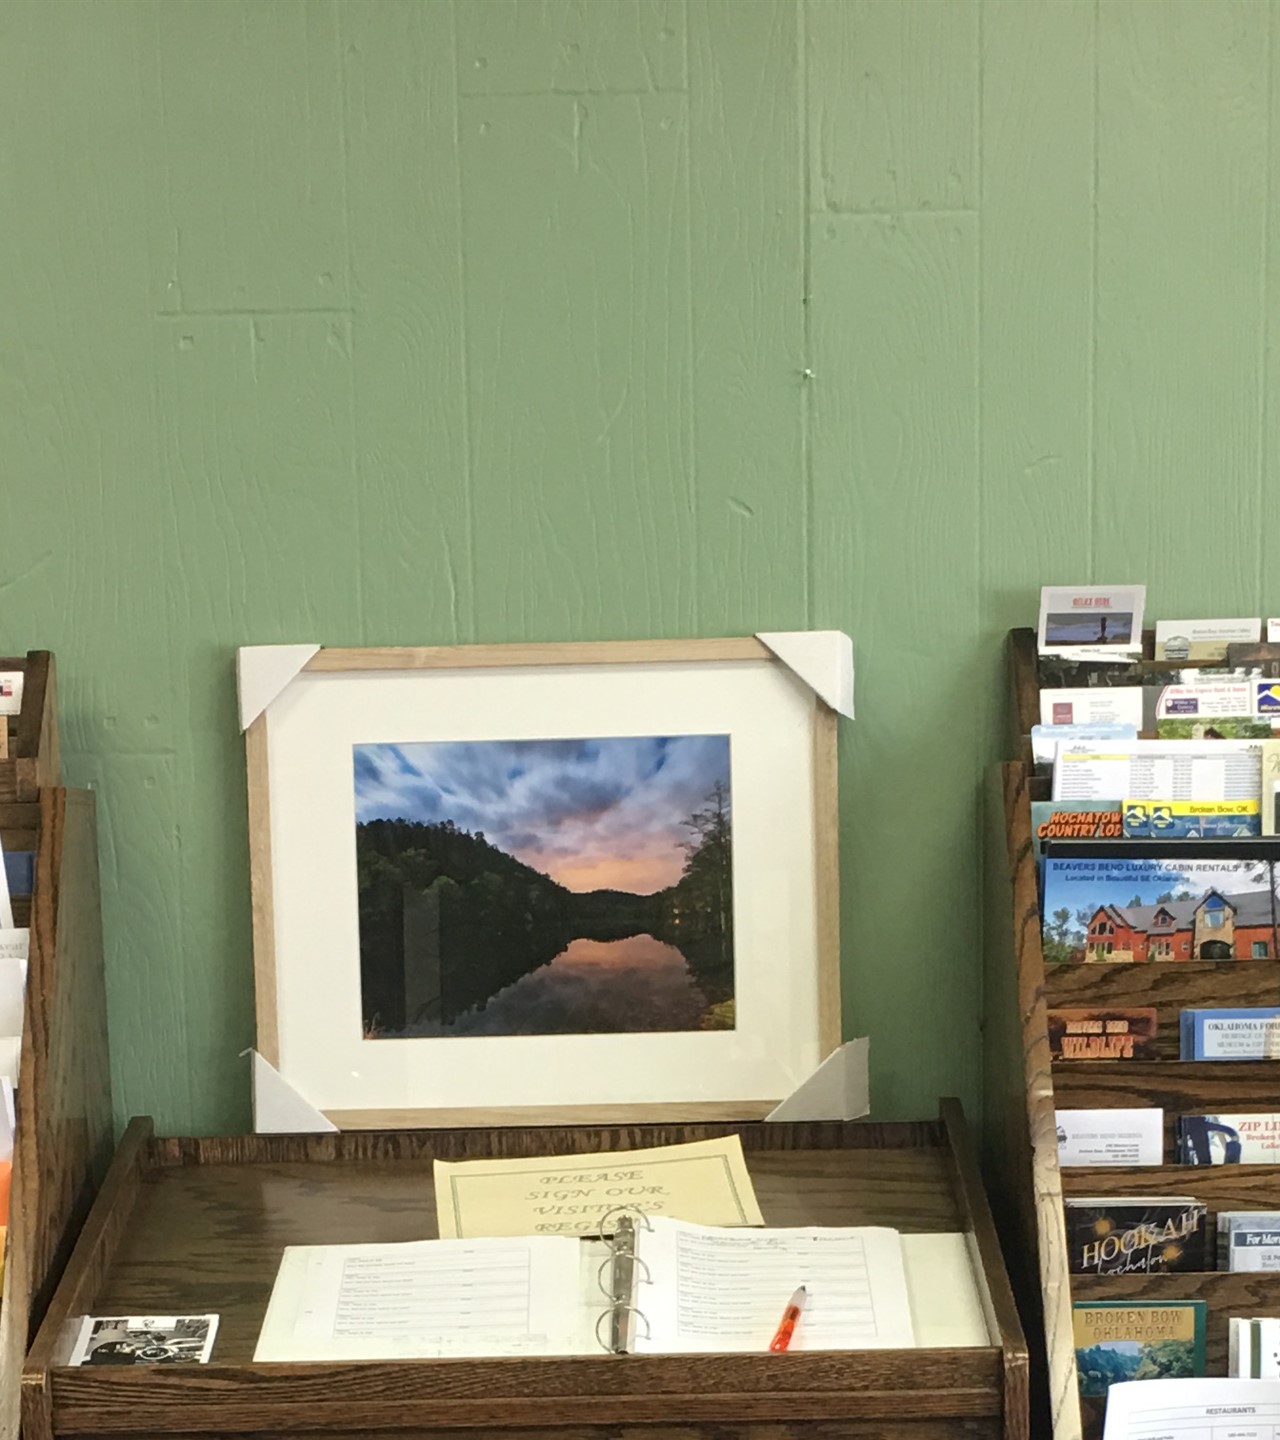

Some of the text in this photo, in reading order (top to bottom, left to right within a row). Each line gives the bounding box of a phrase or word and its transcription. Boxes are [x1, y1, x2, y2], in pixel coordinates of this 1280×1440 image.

[1050, 812, 1122, 824] HOCHATOW
[1037, 824, 1097, 837] COUNTRY
[1053, 863, 1193, 871] BEAVERS BEND LUXURY CABIN
[1238, 1121, 1262, 1131] ZIP
[540, 1170, 644, 1184] PLEASE
[525, 1185, 669, 1199] SIGN OUR
[1081, 1210, 1199, 1269] HOOKAH
[1246, 1233, 1260, 1245] For
[1085, 1311, 1183, 1323] BROKEN BOW
[1093, 1326, 1175, 1338] OKLAHOMA
